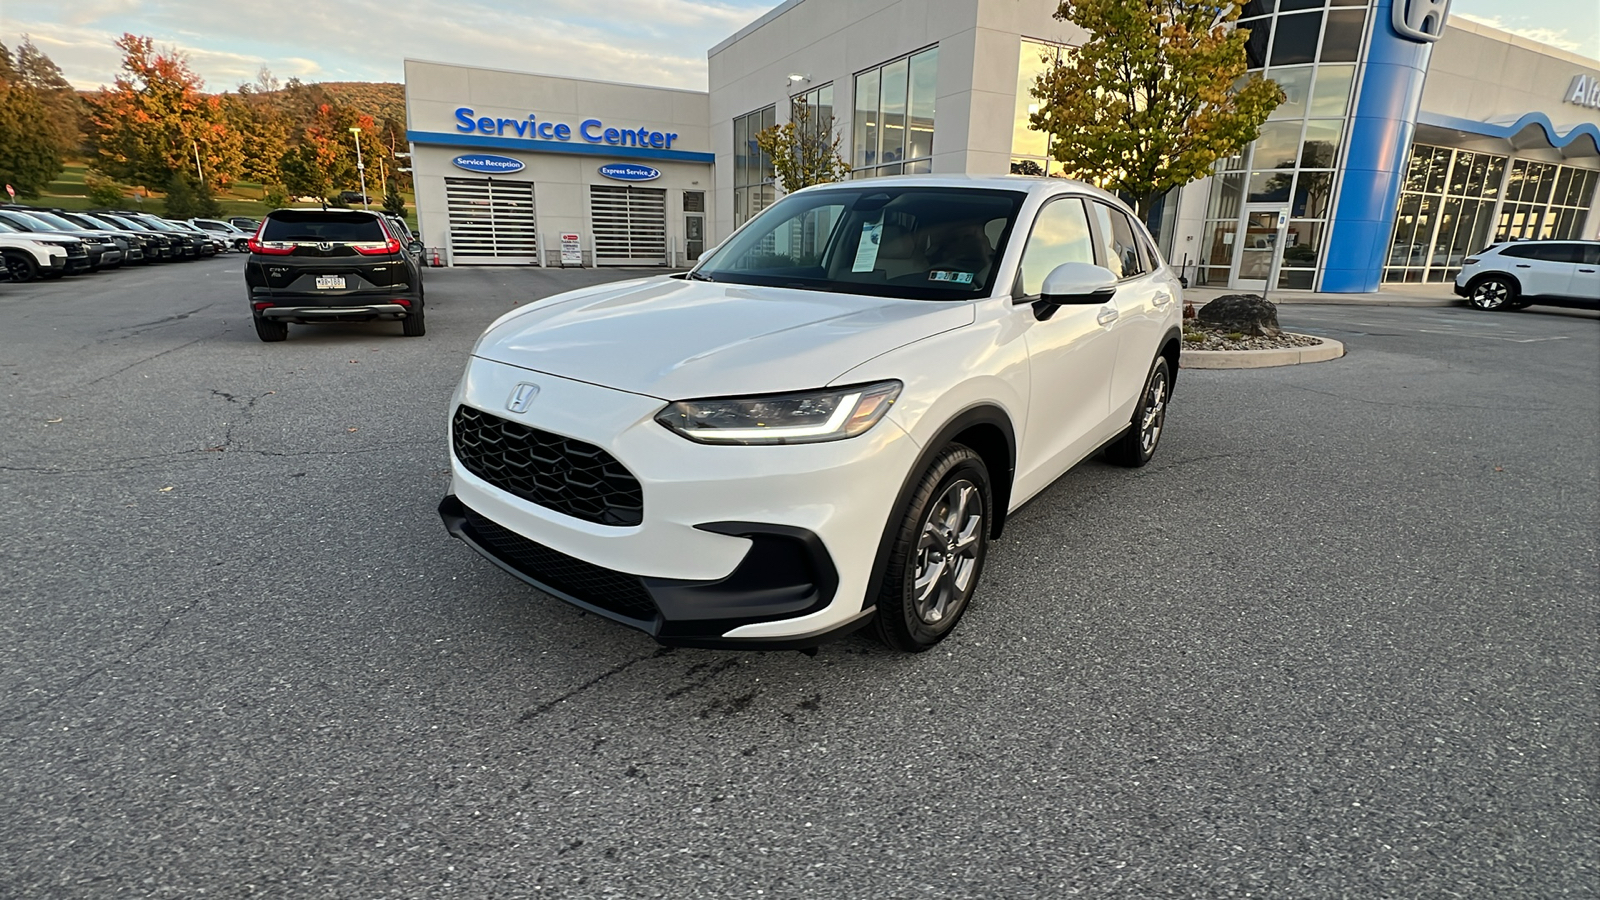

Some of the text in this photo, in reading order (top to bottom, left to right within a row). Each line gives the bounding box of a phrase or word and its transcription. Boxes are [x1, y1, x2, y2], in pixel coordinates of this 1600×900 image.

[455, 107, 678, 148] Service Center
[456, 157, 520, 169] Service Reception
[602, 167, 648, 177] Express Service
